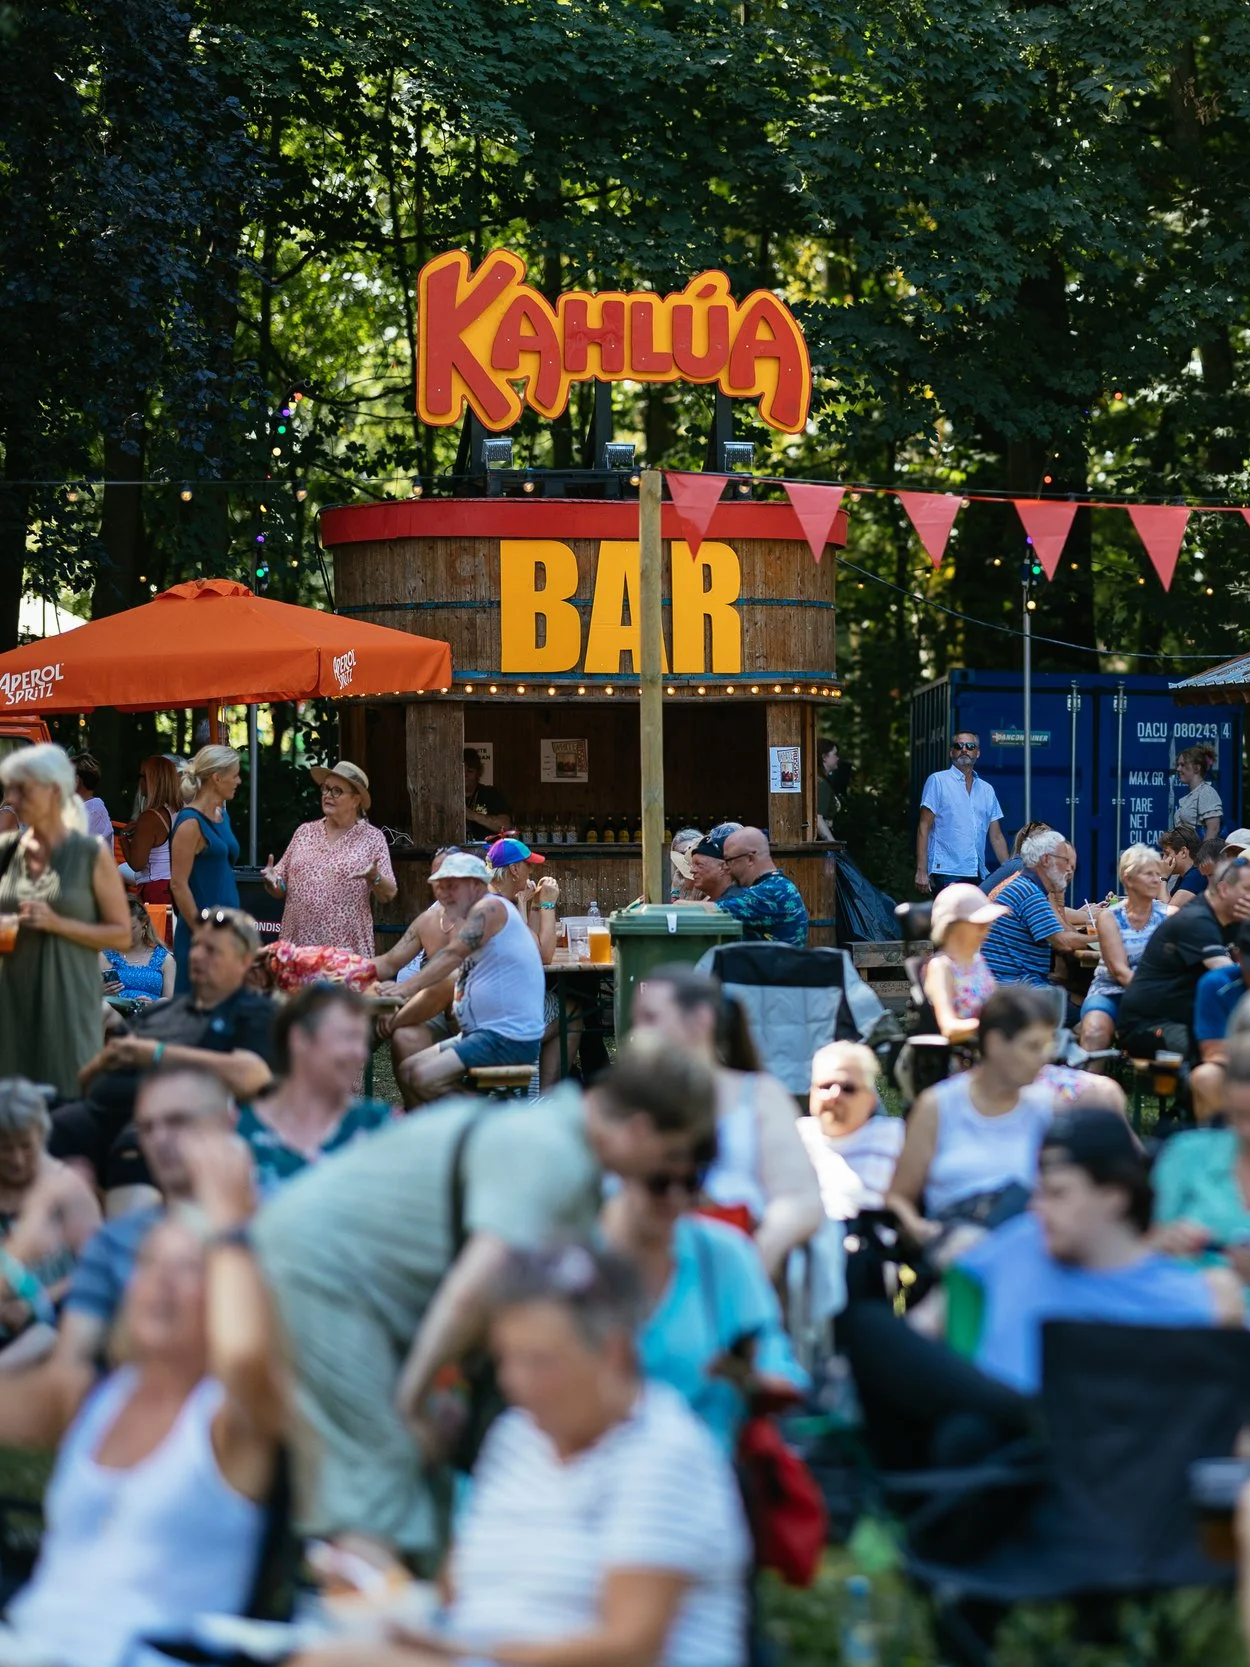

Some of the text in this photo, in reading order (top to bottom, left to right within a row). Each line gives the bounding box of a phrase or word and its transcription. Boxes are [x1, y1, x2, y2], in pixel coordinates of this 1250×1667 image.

[419, 251, 811, 432] KAHLÚA
[499, 540, 742, 674] BAR
[0, 663, 64, 695] APEROL
[996, 732, 1048, 742] DANCONINER
[1137, 722, 1229, 738] DACU 080243 4
[1128, 771, 1166, 786] MAX.GR.
[1130, 798, 1153, 812] TARE
[1130, 814, 1148, 829] NET
